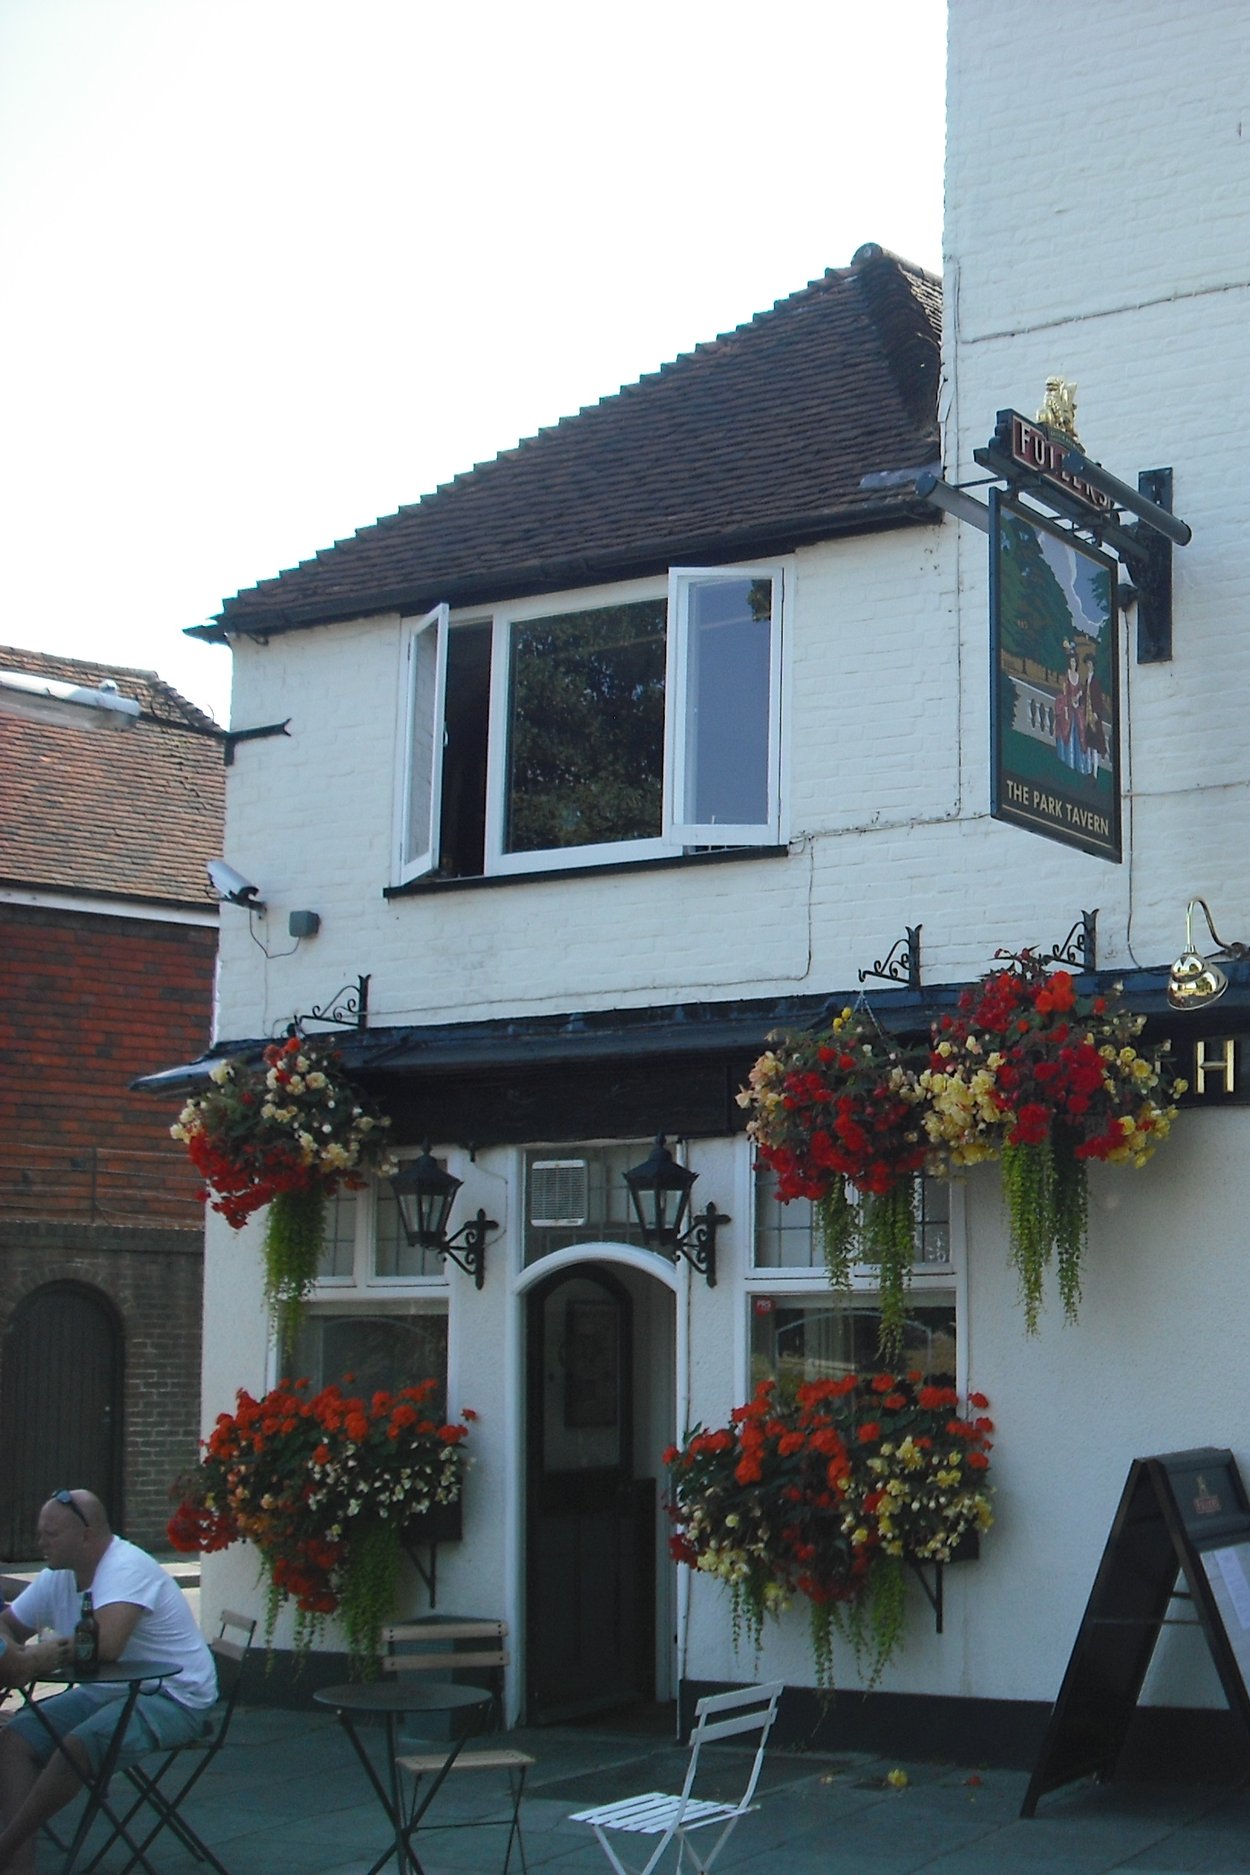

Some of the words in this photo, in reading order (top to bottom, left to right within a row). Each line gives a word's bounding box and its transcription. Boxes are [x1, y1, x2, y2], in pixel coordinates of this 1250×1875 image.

[1006, 780, 1030, 805] THE
[1033, 790, 1063, 818] PARK
[1065, 803, 1110, 837] TAVERN
